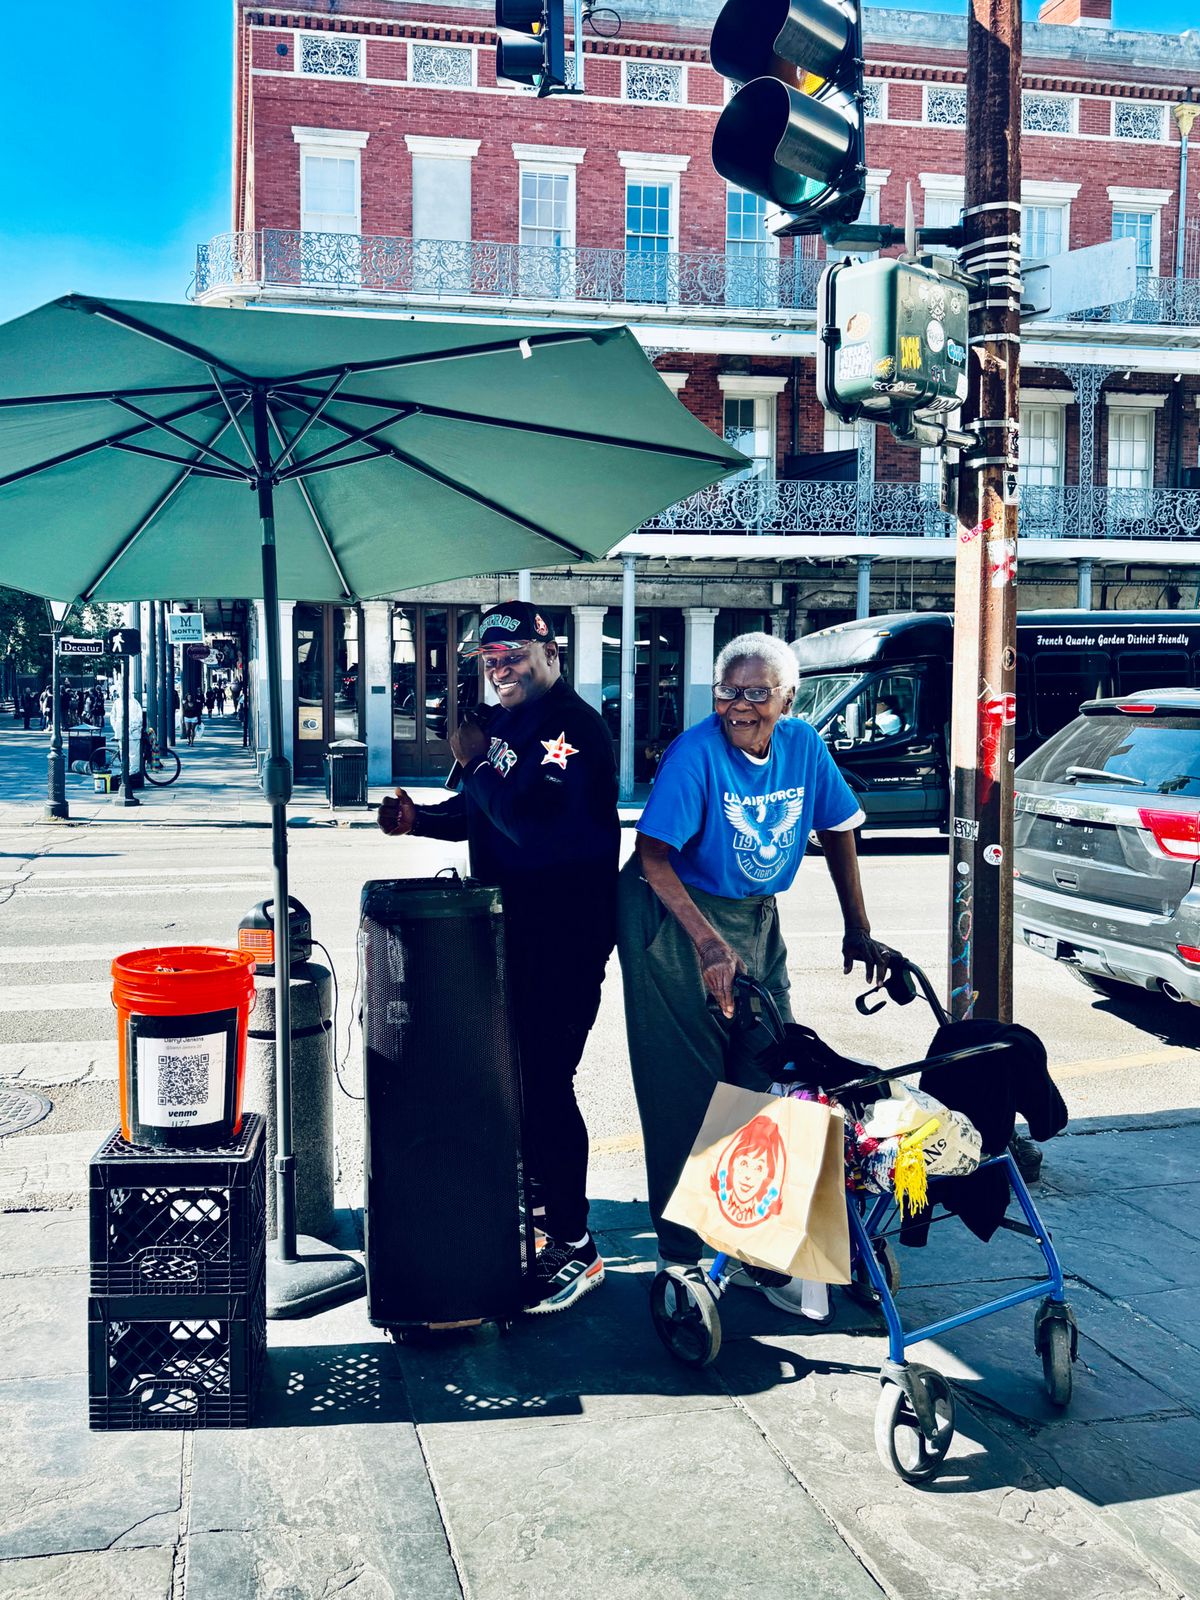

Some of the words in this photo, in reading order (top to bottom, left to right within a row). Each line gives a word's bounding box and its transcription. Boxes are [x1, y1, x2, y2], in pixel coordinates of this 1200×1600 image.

[180, 615, 192, 627] M
[1036, 635, 1063, 646] French
[1065, 635, 1095, 646] Quarter
[1097, 634, 1125, 647] Garden
[1127, 633, 1156, 645] District
[1157, 633, 1189, 646] Friendly
[64, 643, 100, 653] Decatur
[1051, 801, 1077, 816] Jeep
[738, 835, 754, 848] 19
[781, 830, 793, 845] 47
[168, 1110, 198, 1118] venmo
